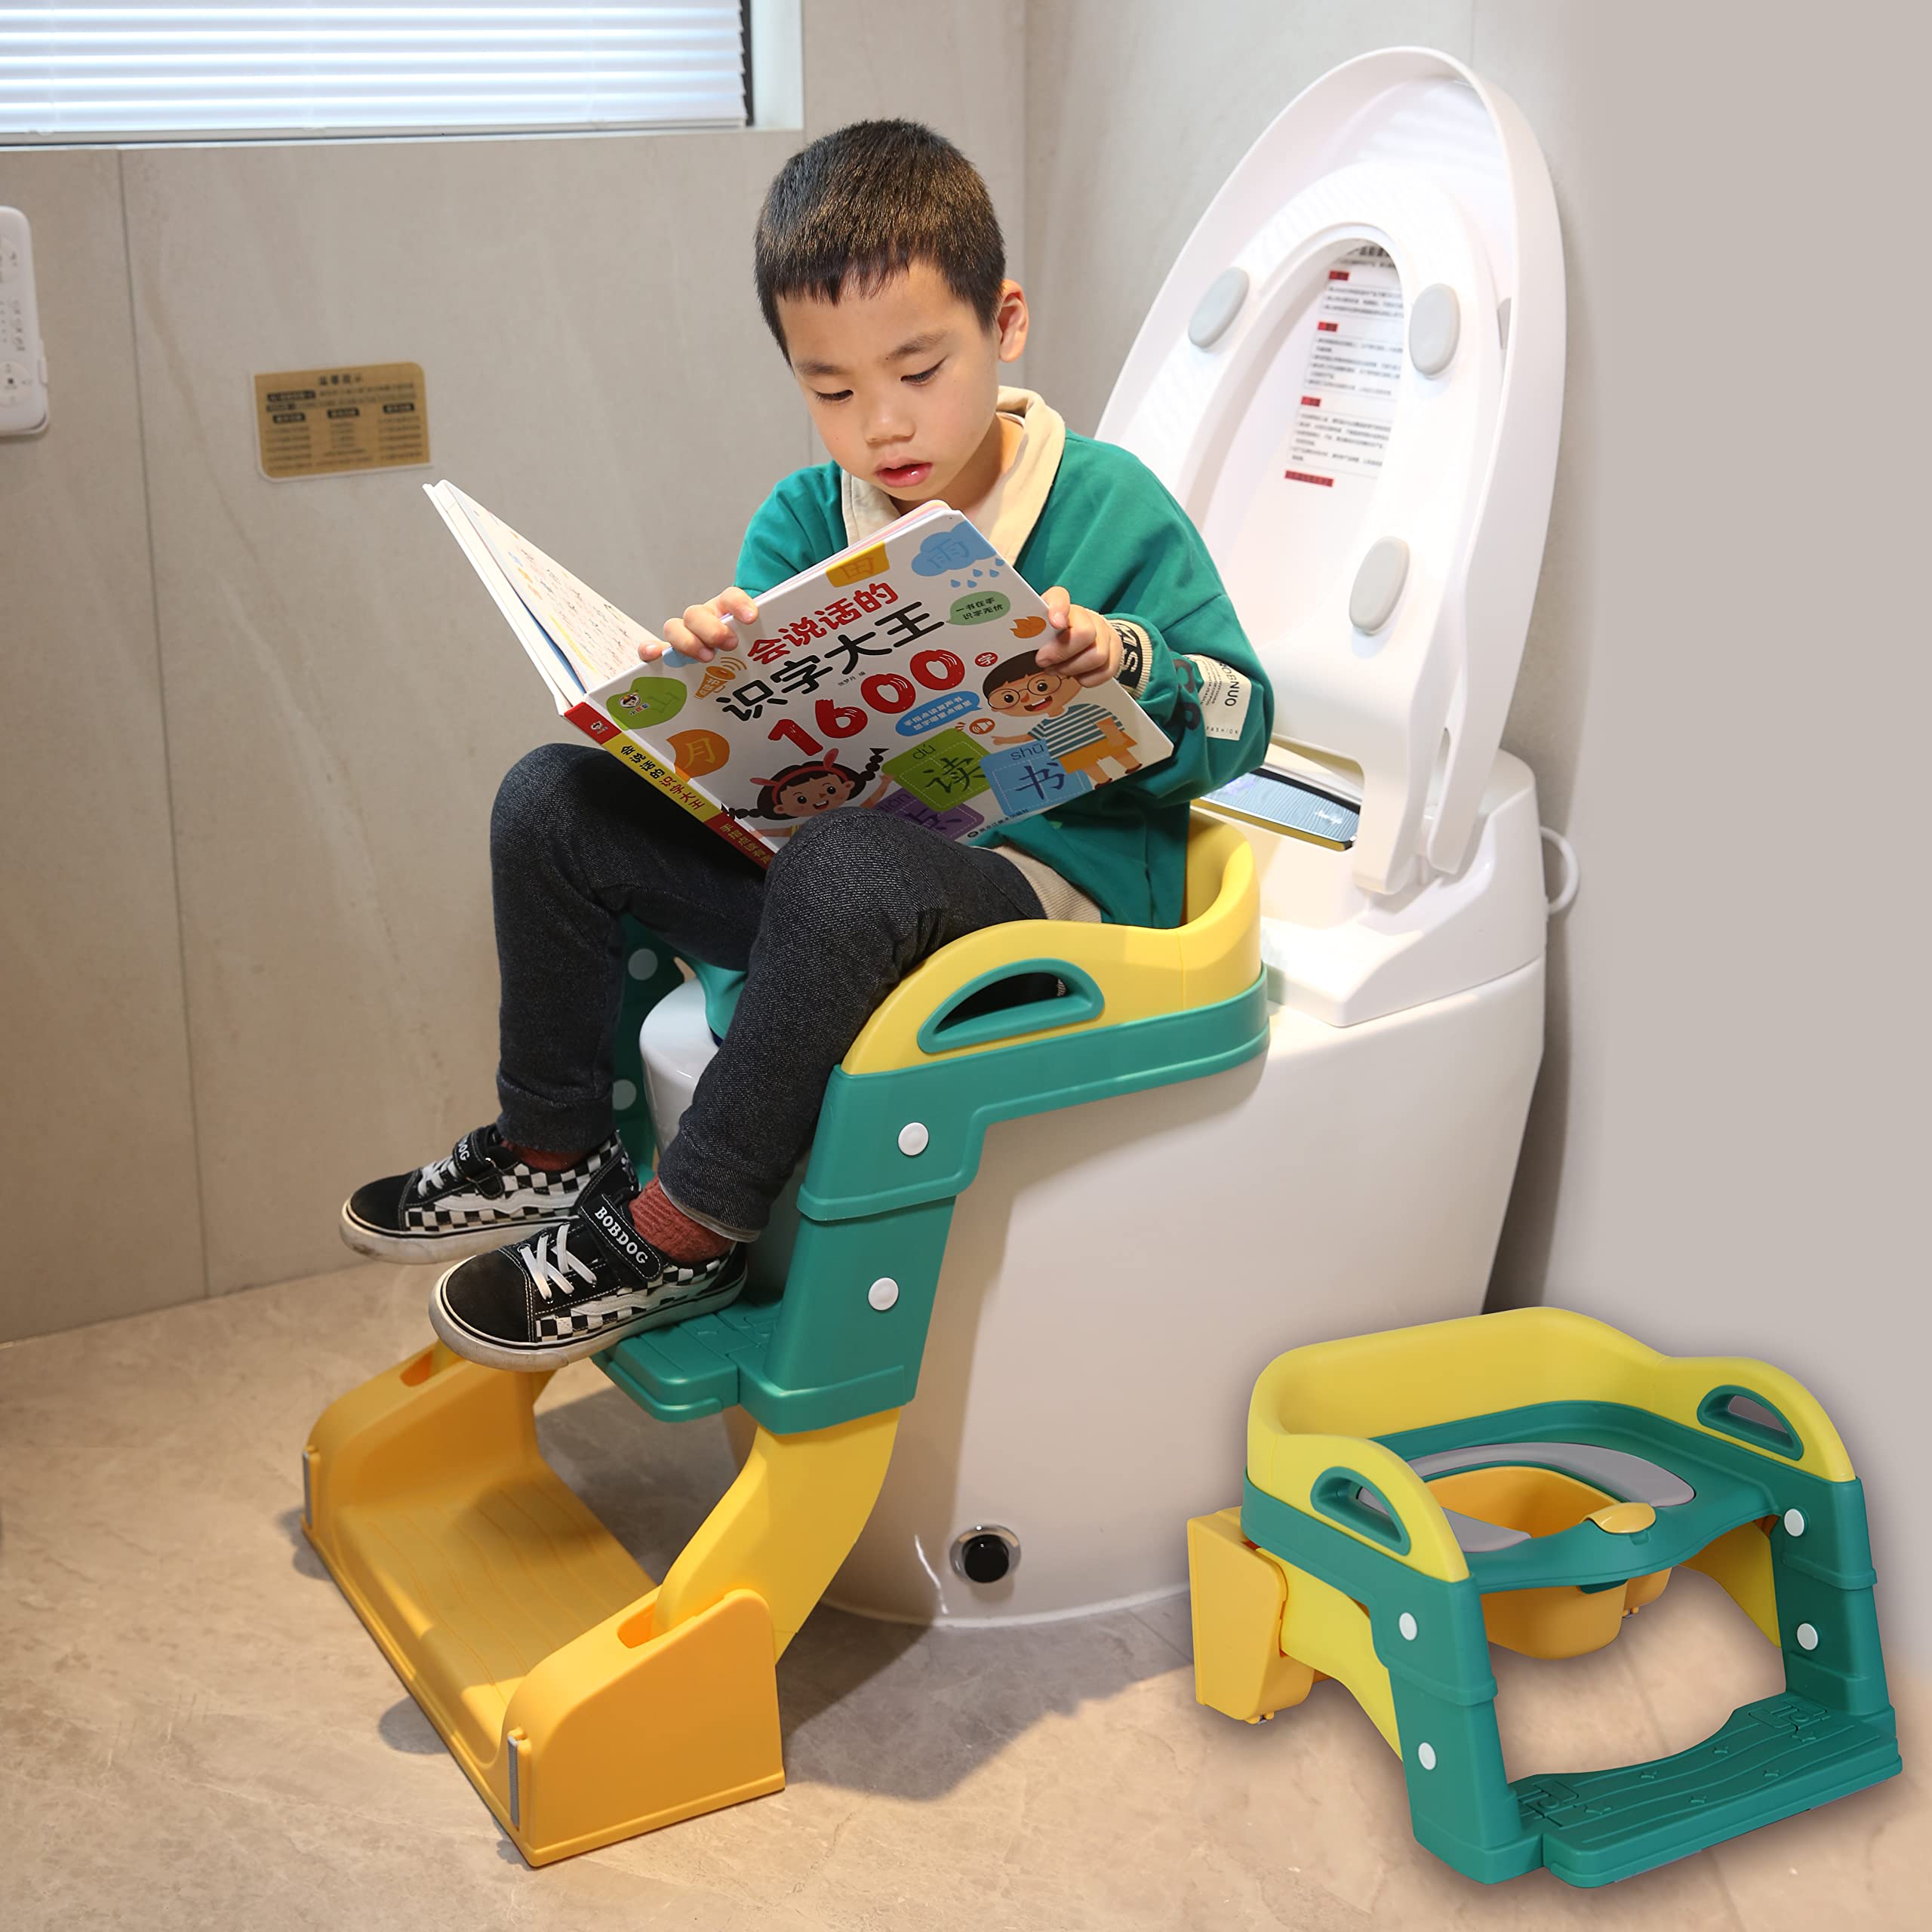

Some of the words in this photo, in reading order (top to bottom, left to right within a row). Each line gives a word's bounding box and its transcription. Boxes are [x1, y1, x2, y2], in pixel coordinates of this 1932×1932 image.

[747, 582, 899, 665] 会说话的
[955, 597, 995, 613] 一书在手
[962, 604, 1004, 620] 识字无忧
[715, 601, 945, 721] 识字大王
[977, 654, 995, 666] 字
[768, 649, 965, 757] 1600
[683, 737, 716, 769] 月
[912, 743, 937, 760] dú
[1010, 743, 1044, 761] shū
[620, 744, 706, 811] 会说话的识字大王
[922, 757, 986, 794] 读
[1014, 762, 1066, 801] 书
[594, 1206, 648, 1264] BOBDOG
